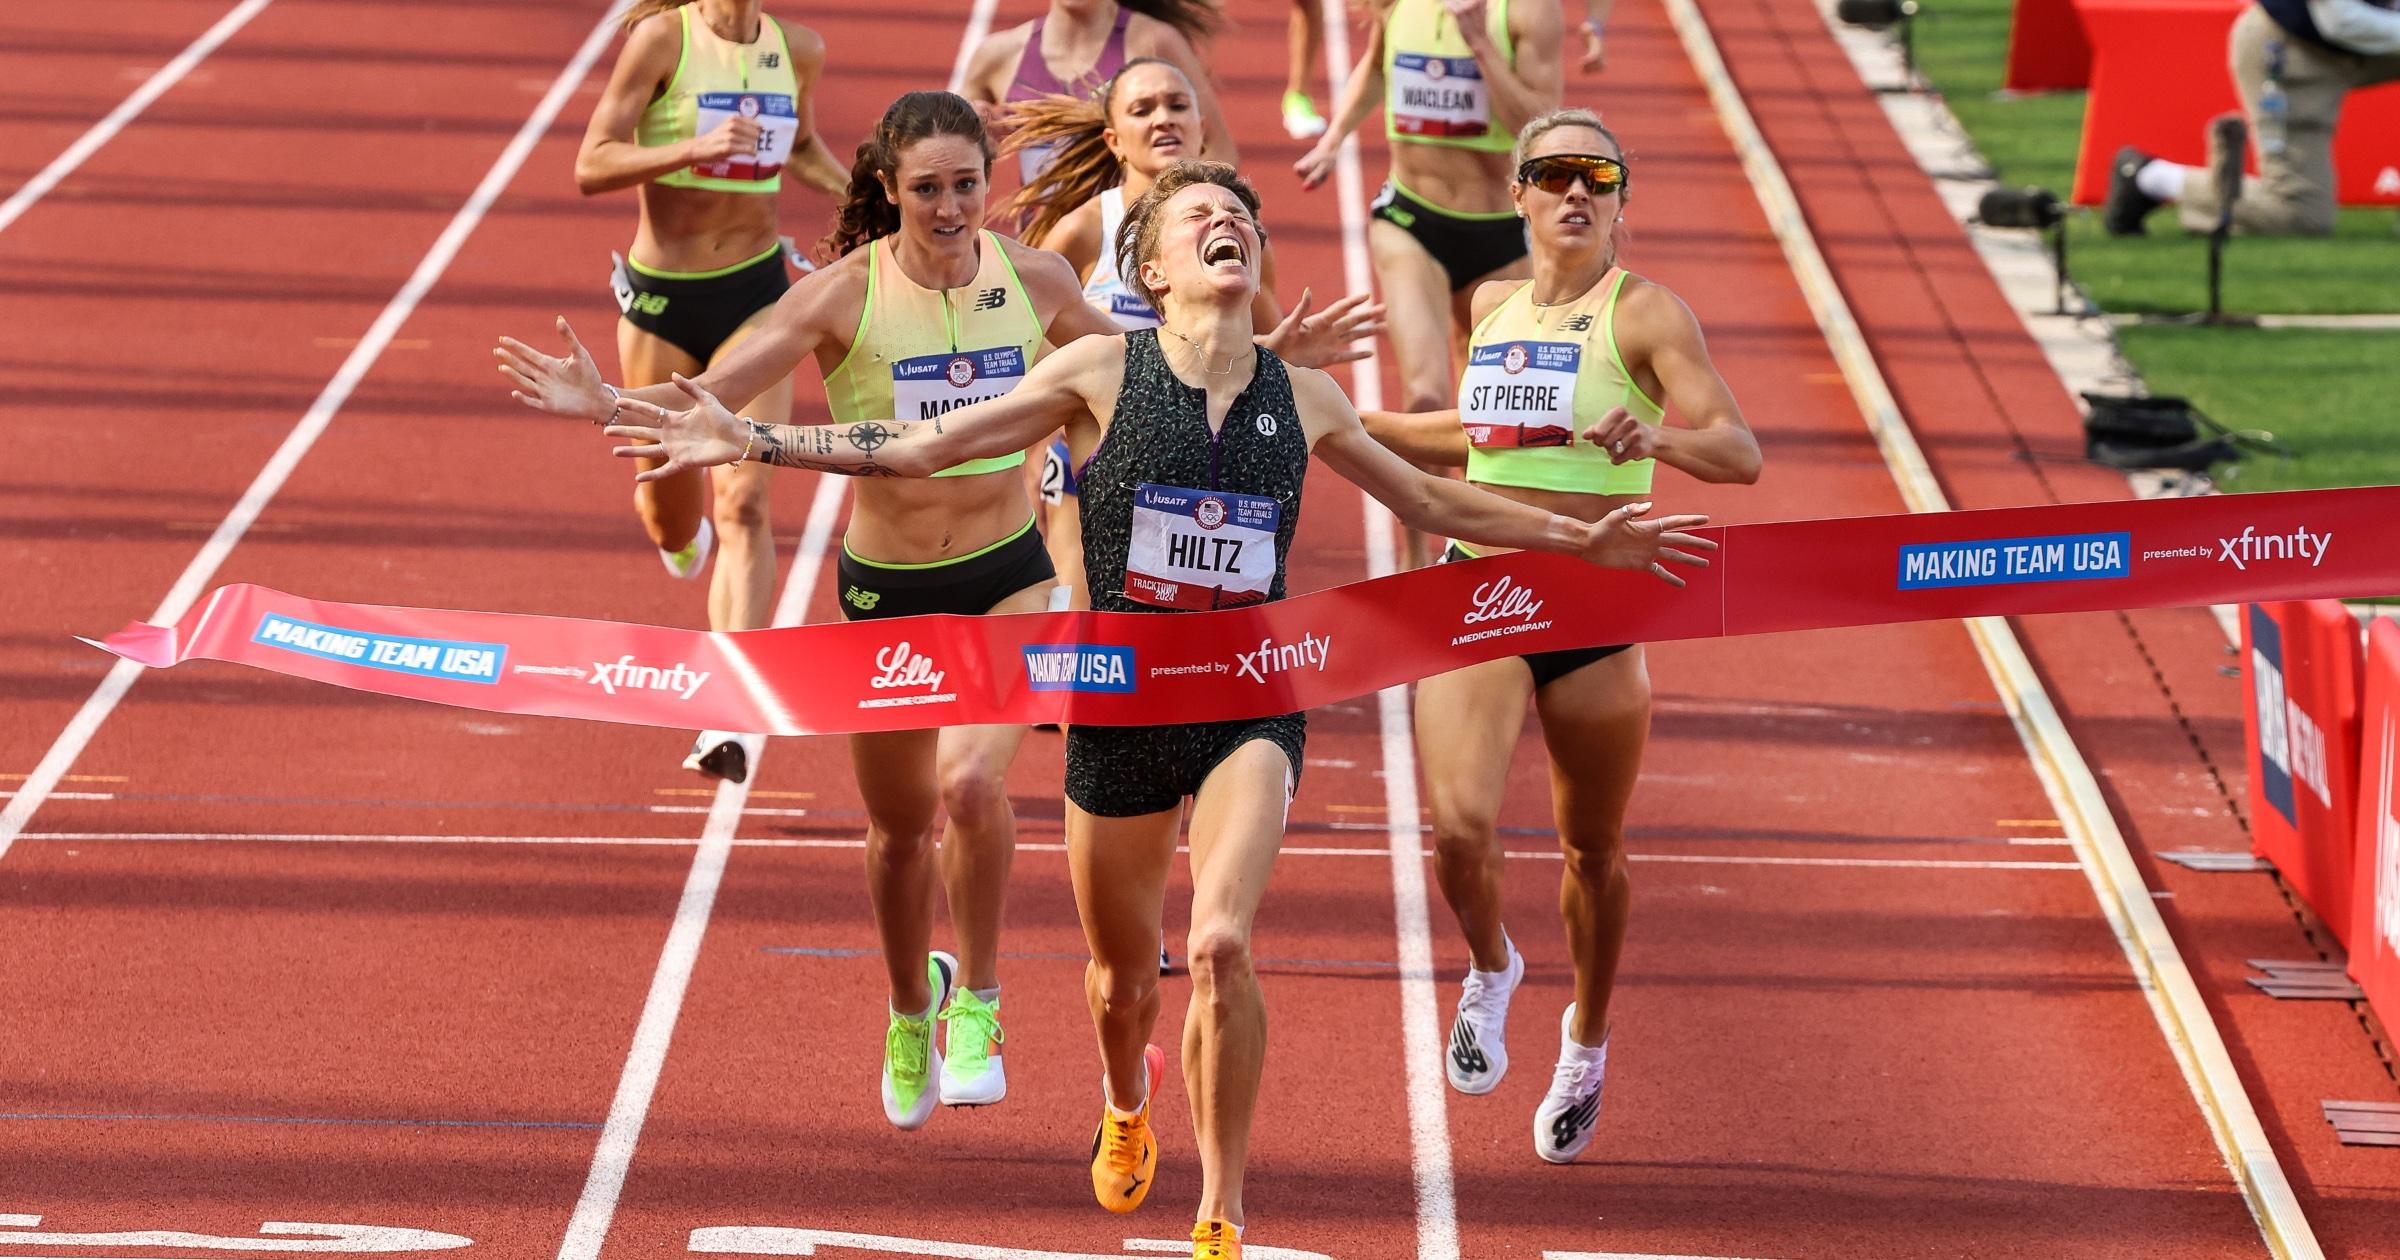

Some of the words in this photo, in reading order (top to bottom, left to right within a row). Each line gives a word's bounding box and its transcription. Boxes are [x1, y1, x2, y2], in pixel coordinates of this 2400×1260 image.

[911, 364, 938, 374] USATF
[1470, 386, 1491, 410] ST
[1494, 386, 1559, 411] PIERRE
[1157, 496, 1188, 506] USATF
[1237, 508, 1252, 517] TEAM
[1253, 510, 1272, 519] TRIALS
[1238, 499, 1249, 509] U.S.
[1250, 500, 1274, 510] OLYMPIC
[1168, 533, 1243, 574] HILTZ
[1906, 548, 1997, 581] MAKING
[2003, 544, 2064, 575] TEAM
[2073, 540, 2121, 571] USA
[2143, 546, 2196, 561] presented
[2200, 546, 2213, 558] by
[2218, 526, 2332, 570] xfinity
[1133, 578, 1178, 594] TRACKTOWN
[1155, 590, 1174, 602] 2024
[1464, 575, 1543, 624] Lilly
[262, 619, 369, 658] MAKING
[368, 640, 440, 670] TEAM
[440, 648, 496, 676] USA
[1451, 637, 1458, 646] A
[1459, 628, 1502, 645] MEDICINE
[1503, 620, 1552, 635] COMPANY
[871, 641, 945, 692] Lilly
[1026, 653, 1061, 682] MAKING
[1060, 653, 1078, 682] TEAM
[1080, 653, 1126, 684] USA
[1151, 663, 1211, 678] presented
[1215, 662, 1230, 675] by
[1235, 631, 1331, 684] xfinity
[587, 655, 711, 699] xfinity
